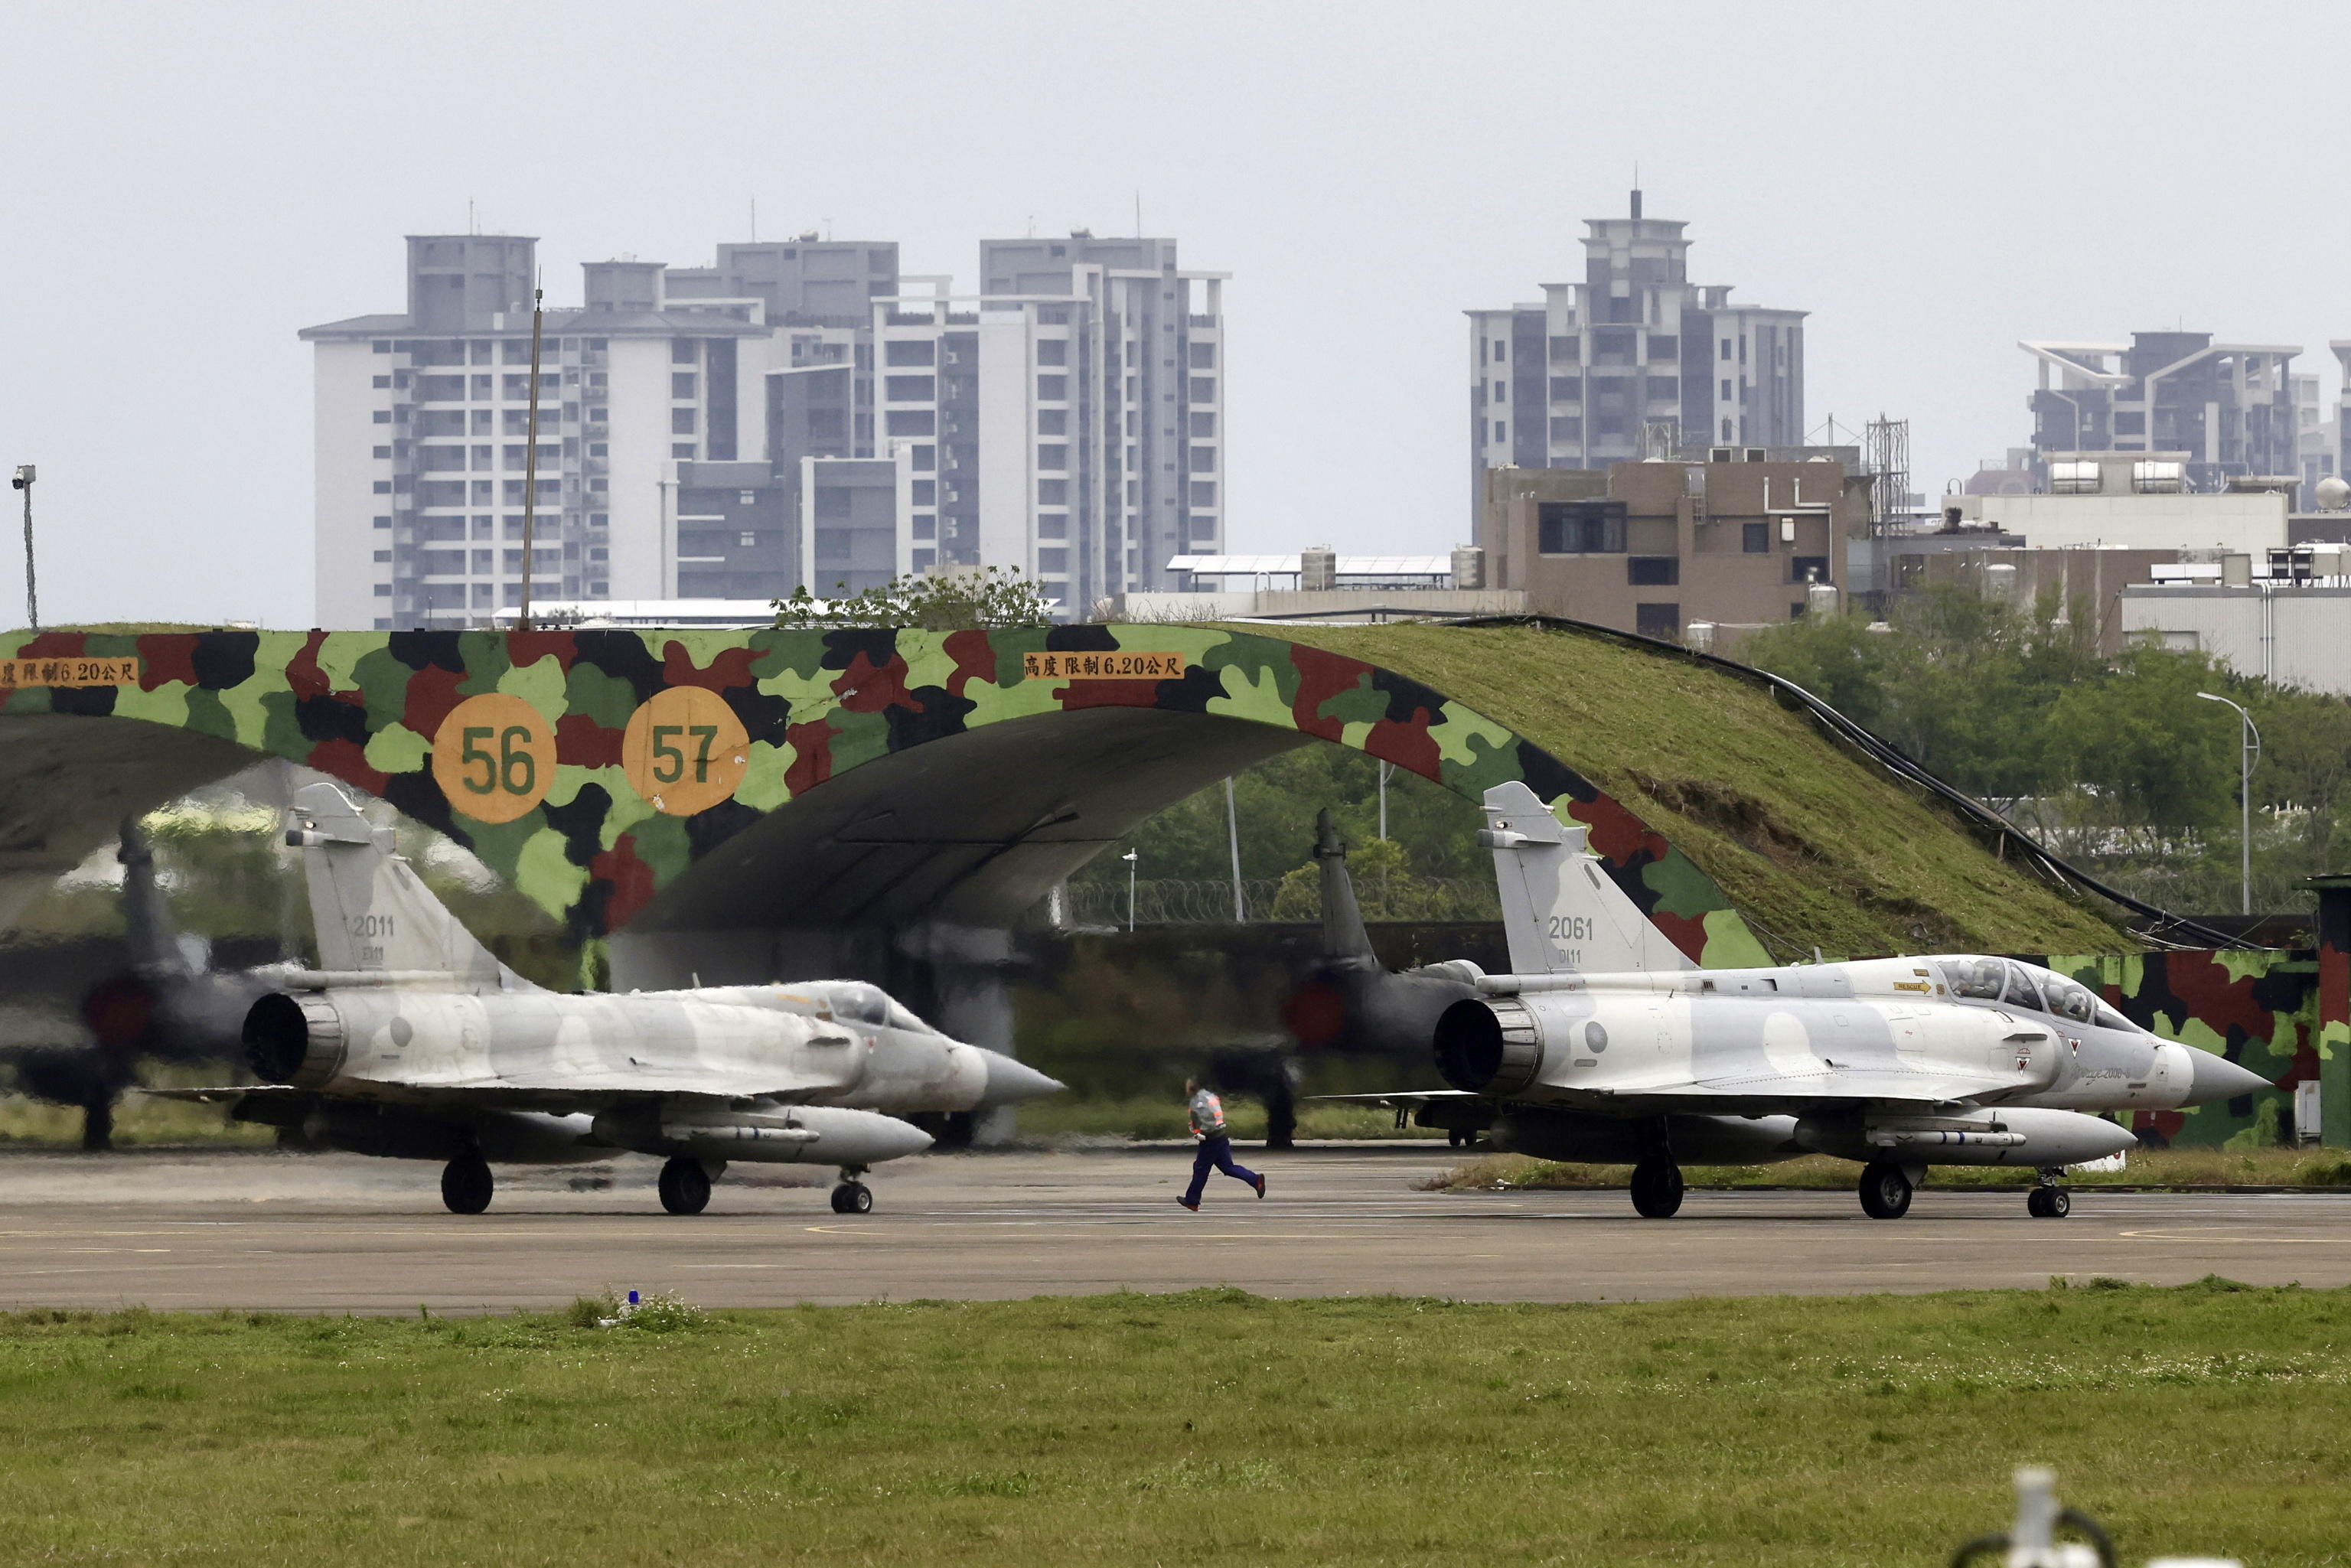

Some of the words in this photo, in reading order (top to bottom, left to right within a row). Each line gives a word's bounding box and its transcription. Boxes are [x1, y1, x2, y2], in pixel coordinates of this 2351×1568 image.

[1025, 656, 1181, 676] 高度限制6.20公尺
[462, 725, 535, 795] 56
[653, 725, 718, 783] 57
[354, 915, 393, 937] 2011
[1549, 916, 1592, 940] 2061
